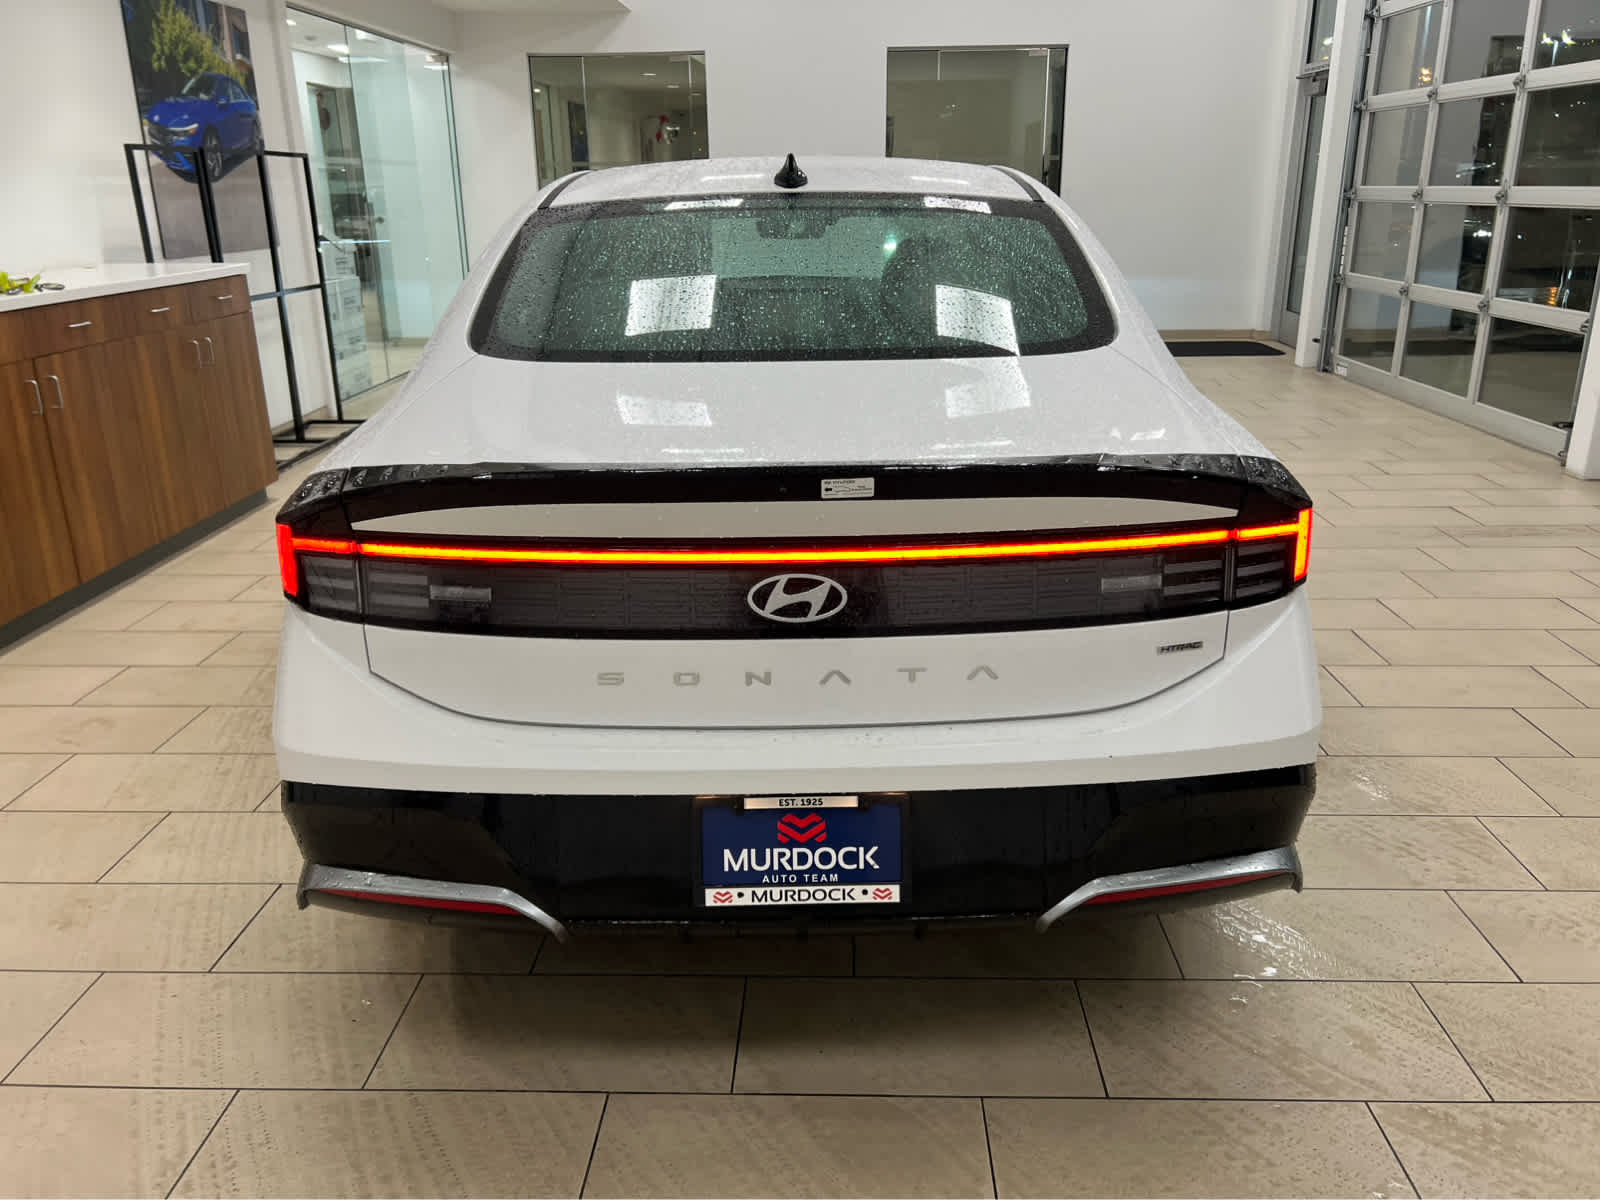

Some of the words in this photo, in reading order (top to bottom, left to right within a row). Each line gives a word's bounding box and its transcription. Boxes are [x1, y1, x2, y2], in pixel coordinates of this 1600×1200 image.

[597, 664, 999, 687] SONATA
[778, 799, 798, 807] EST.
[800, 798, 823, 806] 1925
[723, 846, 880, 872] MURDOCK
[762, 874, 797, 884] AUTO
[803, 873, 839, 883] TEAM
[751, 888, 856, 903] MURDOCK
